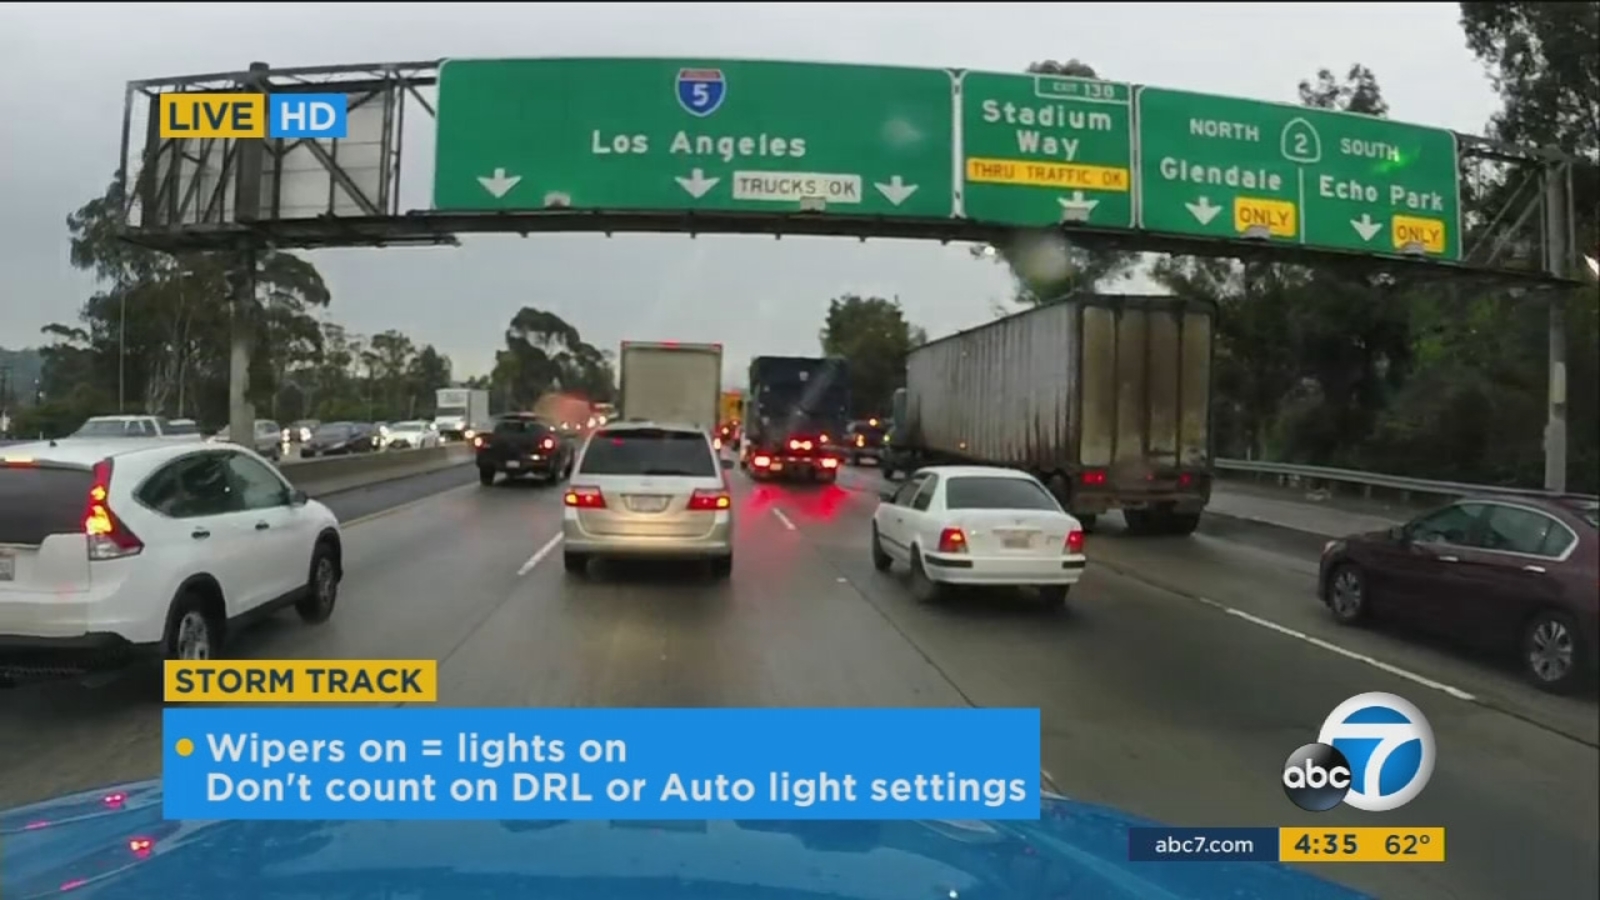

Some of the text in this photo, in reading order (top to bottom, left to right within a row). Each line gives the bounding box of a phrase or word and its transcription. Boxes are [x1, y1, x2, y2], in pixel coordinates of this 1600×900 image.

[692, 83, 709, 107] 5
[982, 99, 1111, 131] Stadium
[1189, 118, 1260, 142] NORTH
[592, 129, 807, 163] Los Angeles
[1016, 129, 1079, 161] Way
[1294, 132, 1308, 154] 2
[1340, 137, 1400, 162] SOUTH
[972, 161, 1123, 186] THRU TRAFFIC OK
[1159, 156, 1283, 191] Glendale
[739, 177, 856, 196] TRUCKS OK
[1319, 174, 1444, 212] Echo Park
[1239, 206, 1291, 227] ONLY
[1396, 224, 1441, 244] ONLY
